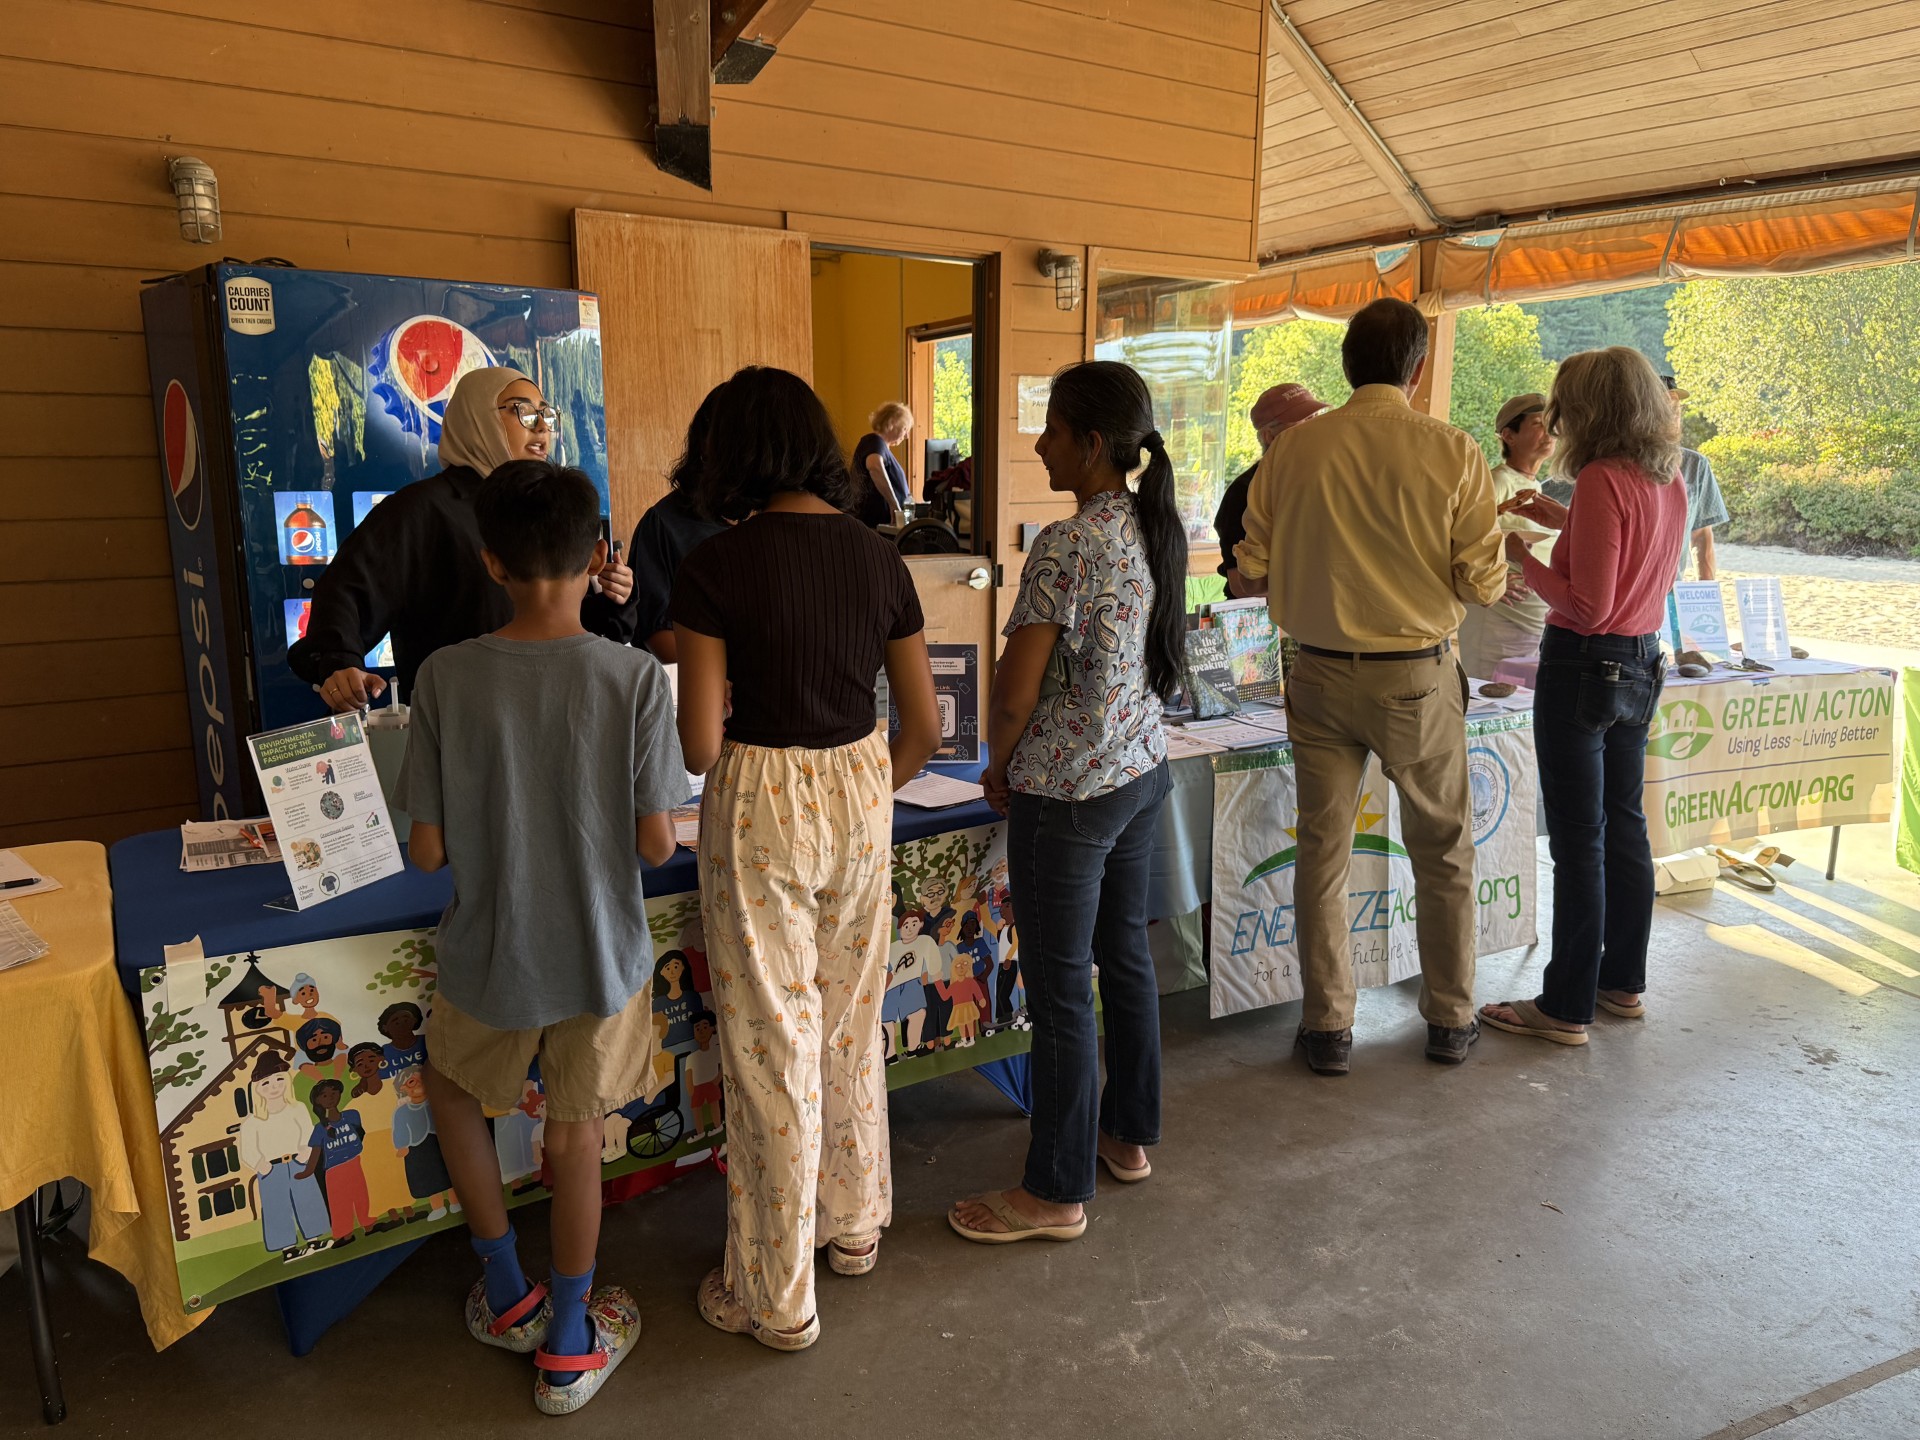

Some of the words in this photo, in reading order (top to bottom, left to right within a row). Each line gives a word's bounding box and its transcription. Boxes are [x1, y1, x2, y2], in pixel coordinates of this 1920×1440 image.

[228, 286, 270, 297] CALORIES
[230, 297, 270, 311] COUNT
[1678, 590, 1718, 600] WELCOME!
[1680, 605, 1700, 613] GREEN
[1701, 604, 1721, 612] ACTON
[1202, 637, 1217, 647] the
[1194, 646, 1217, 656] trees
[1210, 653, 1224, 661] are
[1189, 660, 1229, 675] speaking
[1722, 694, 1808, 731] GREEN
[1814, 686, 1892, 723] ACTON
[259, 731, 316, 750] ENVIRONMENTAL
[261, 746, 287, 757] IMPACT
[299, 739, 312, 748] THE
[1728, 736, 1761, 757] Using
[1763, 732, 1790, 750] Less
[1803, 728, 1836, 750] Living
[1840, 725, 1879, 742] Better
[263, 752, 294, 765] FASHION
[294, 742, 327, 756] INDUSTRY
[1253, 961, 1277, 985] for
[1282, 963, 1292, 977] a
[1351, 939, 1403, 966] future
[665, 1001, 687, 1015] LIVE
[667, 1010, 693, 1025] NITE
[392, 1051, 422, 1066] LIVE
